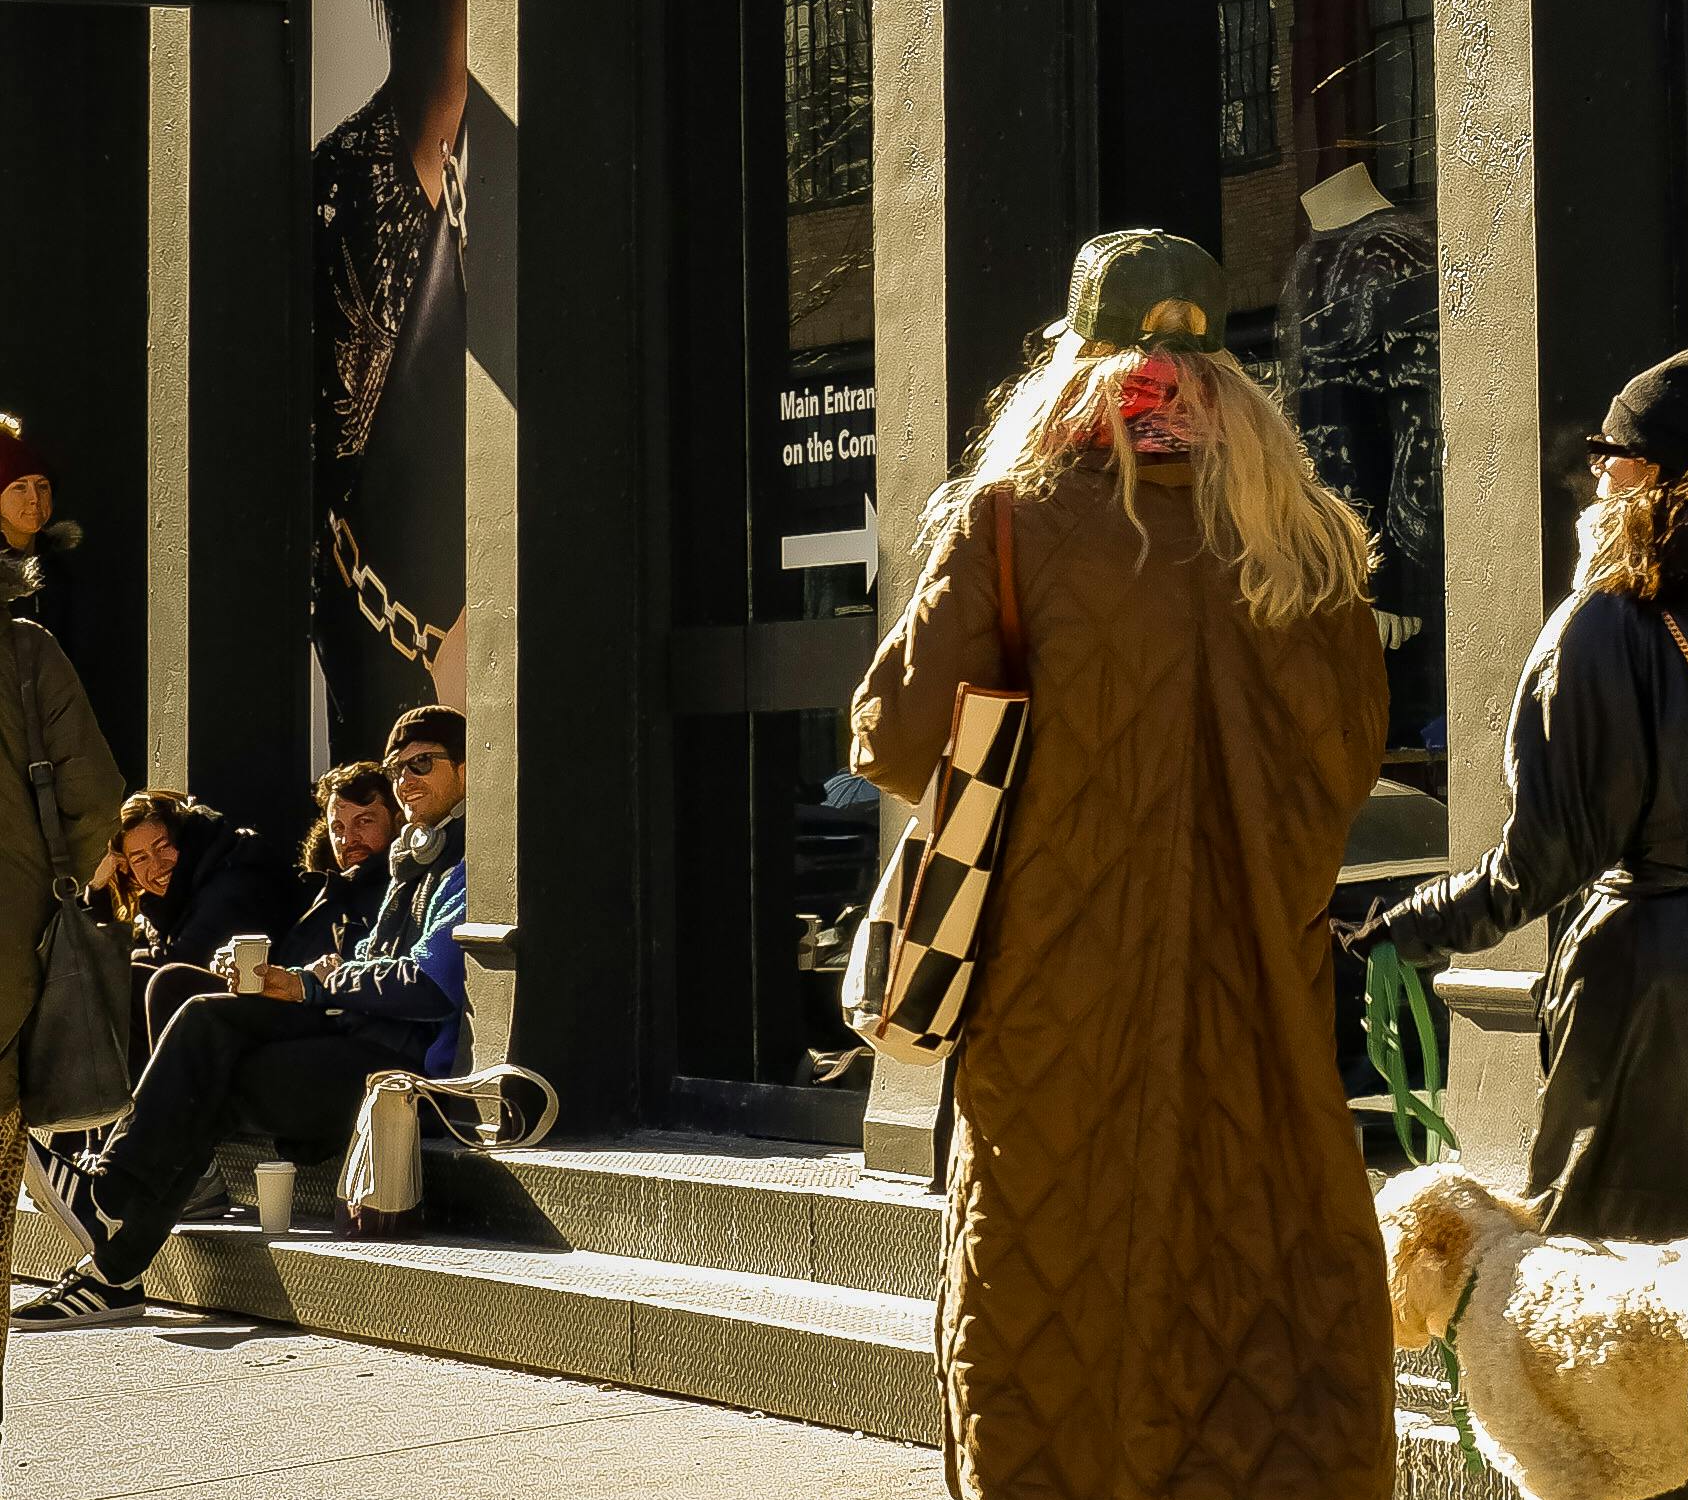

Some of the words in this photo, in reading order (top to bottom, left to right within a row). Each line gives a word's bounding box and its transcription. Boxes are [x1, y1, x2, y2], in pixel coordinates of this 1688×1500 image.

[780, 387, 819, 421] Main
[782, 443, 803, 467] on
[806, 431, 833, 463] the
